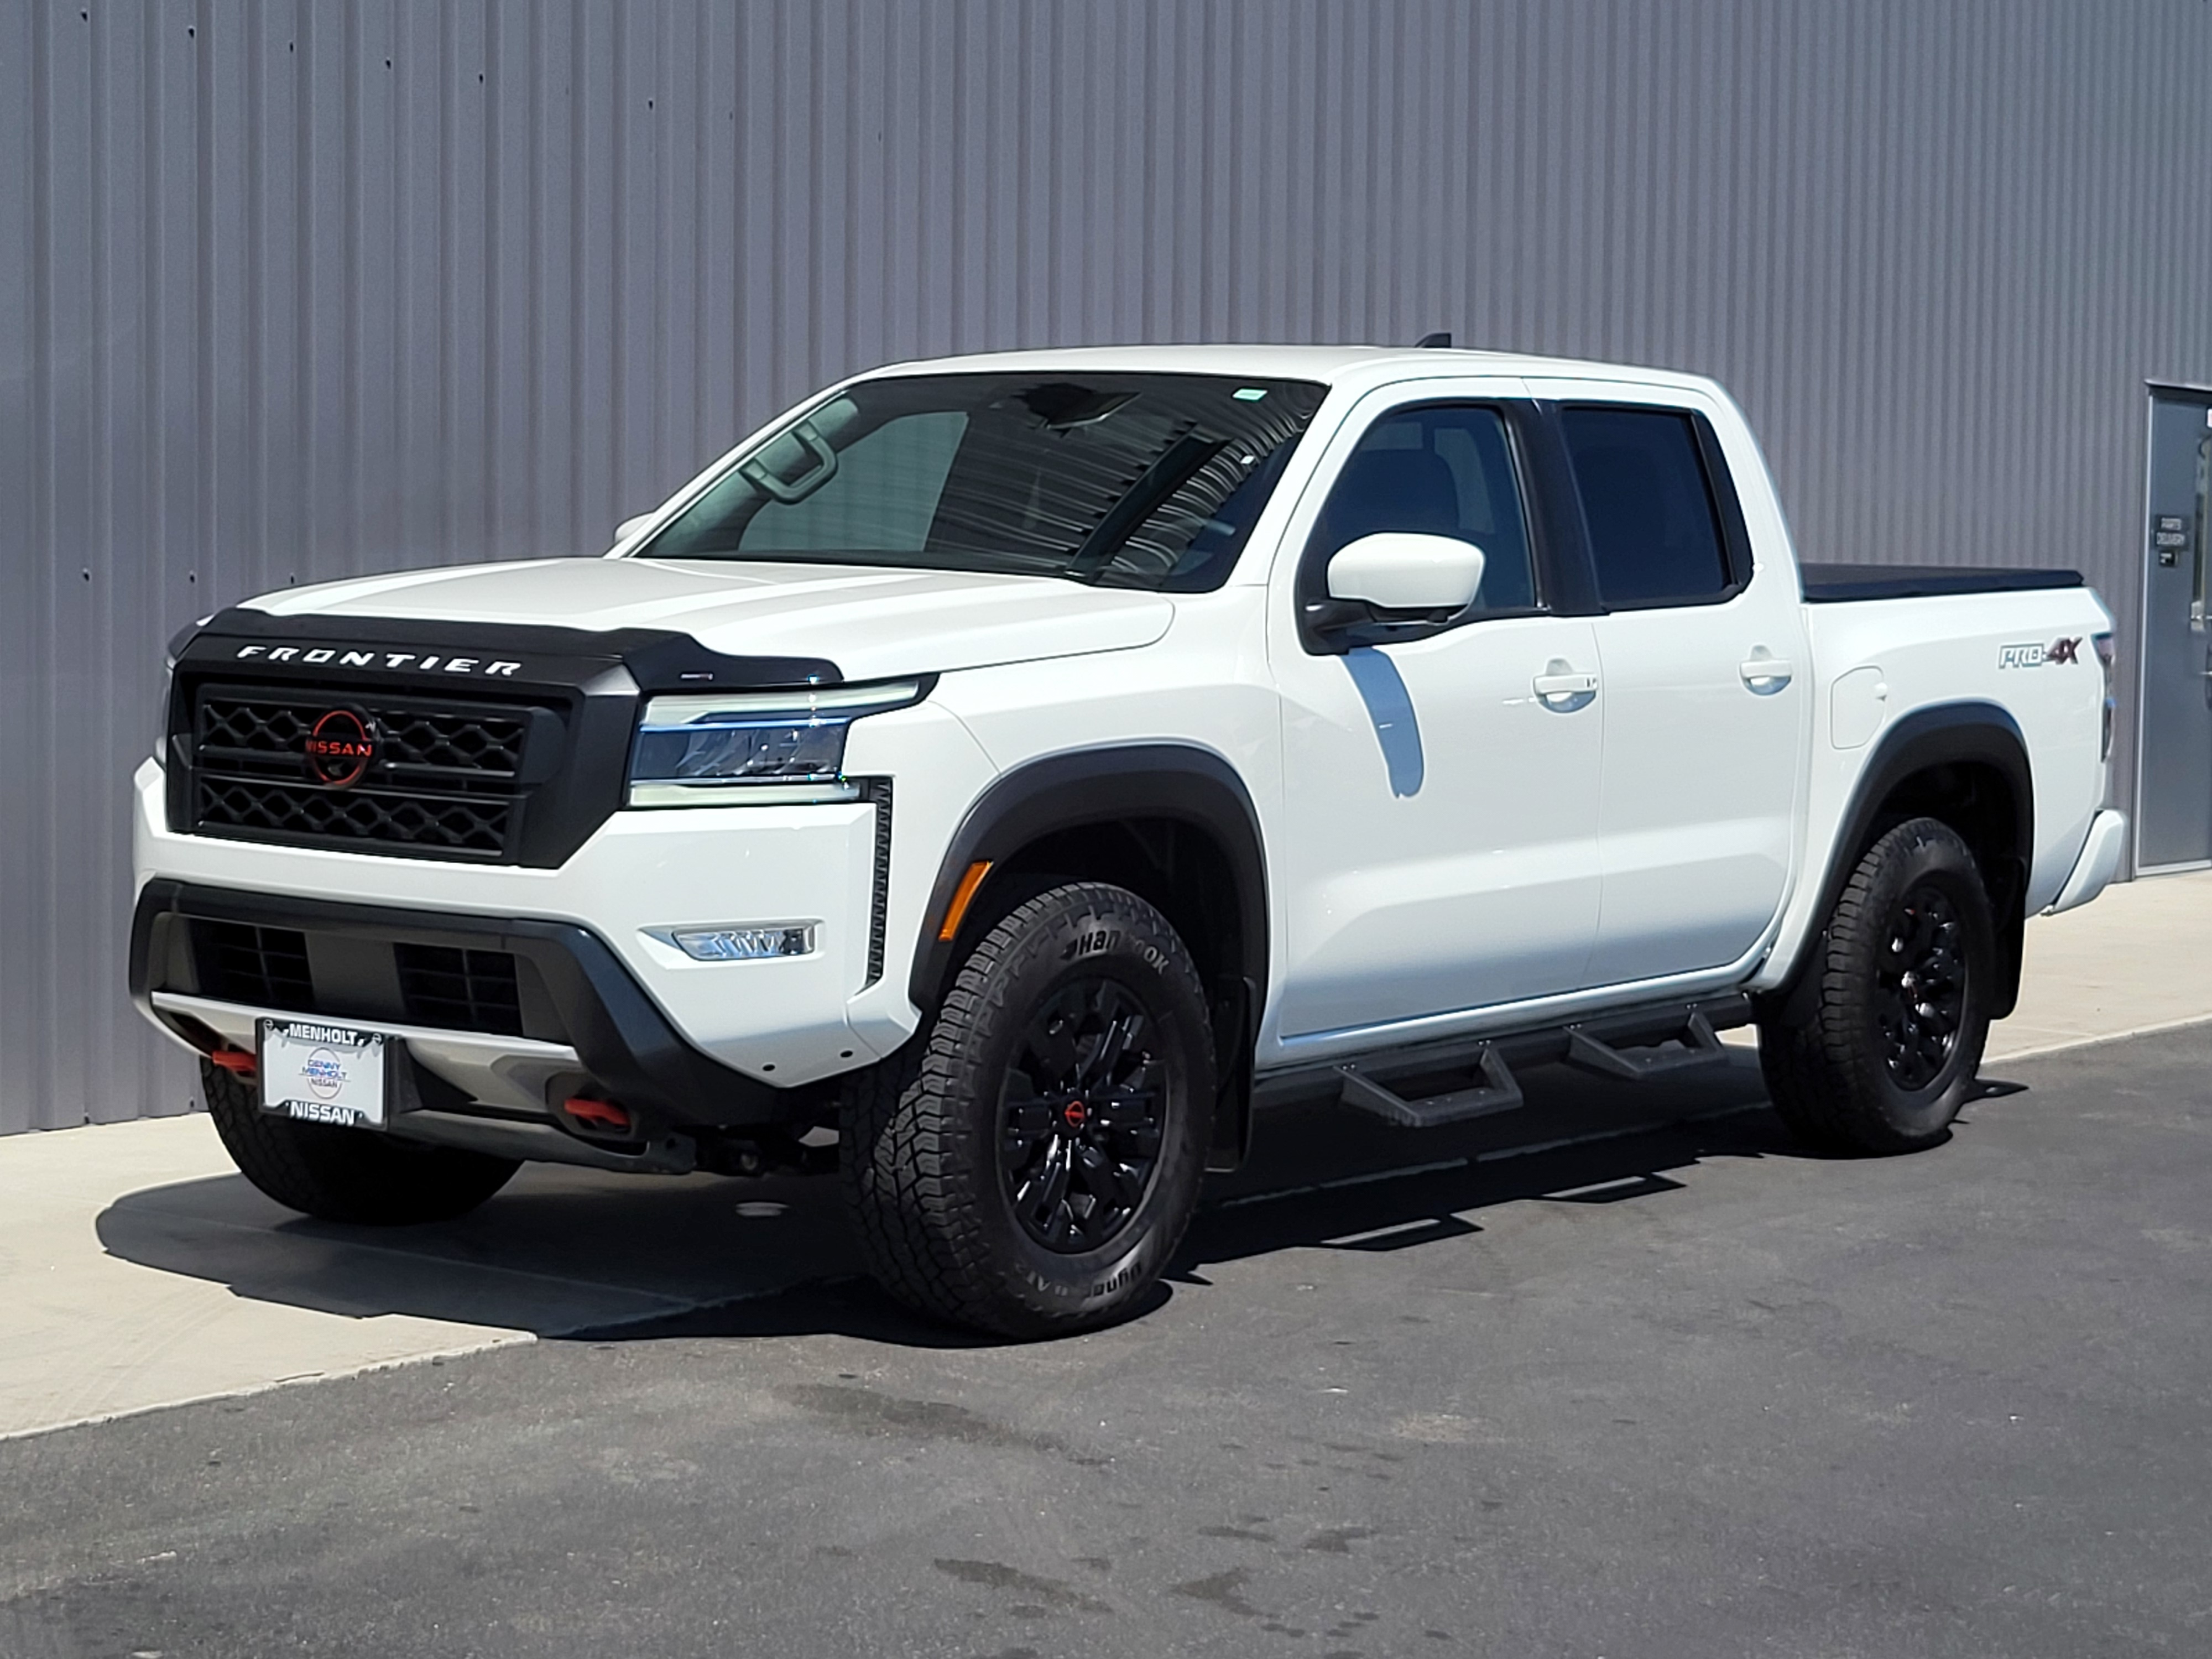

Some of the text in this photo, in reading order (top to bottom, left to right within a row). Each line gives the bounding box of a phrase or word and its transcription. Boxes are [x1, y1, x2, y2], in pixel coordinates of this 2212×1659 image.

[237, 645, 521, 676] FRONTIER
[1999, 637, 2083, 669] PRO-4X
[306, 738, 372, 757] NISSAN
[289, 1024, 358, 1045] MENHOLT
[311, 1078, 338, 1088] NISSAN
[290, 1100, 355, 1126] NISSAN
